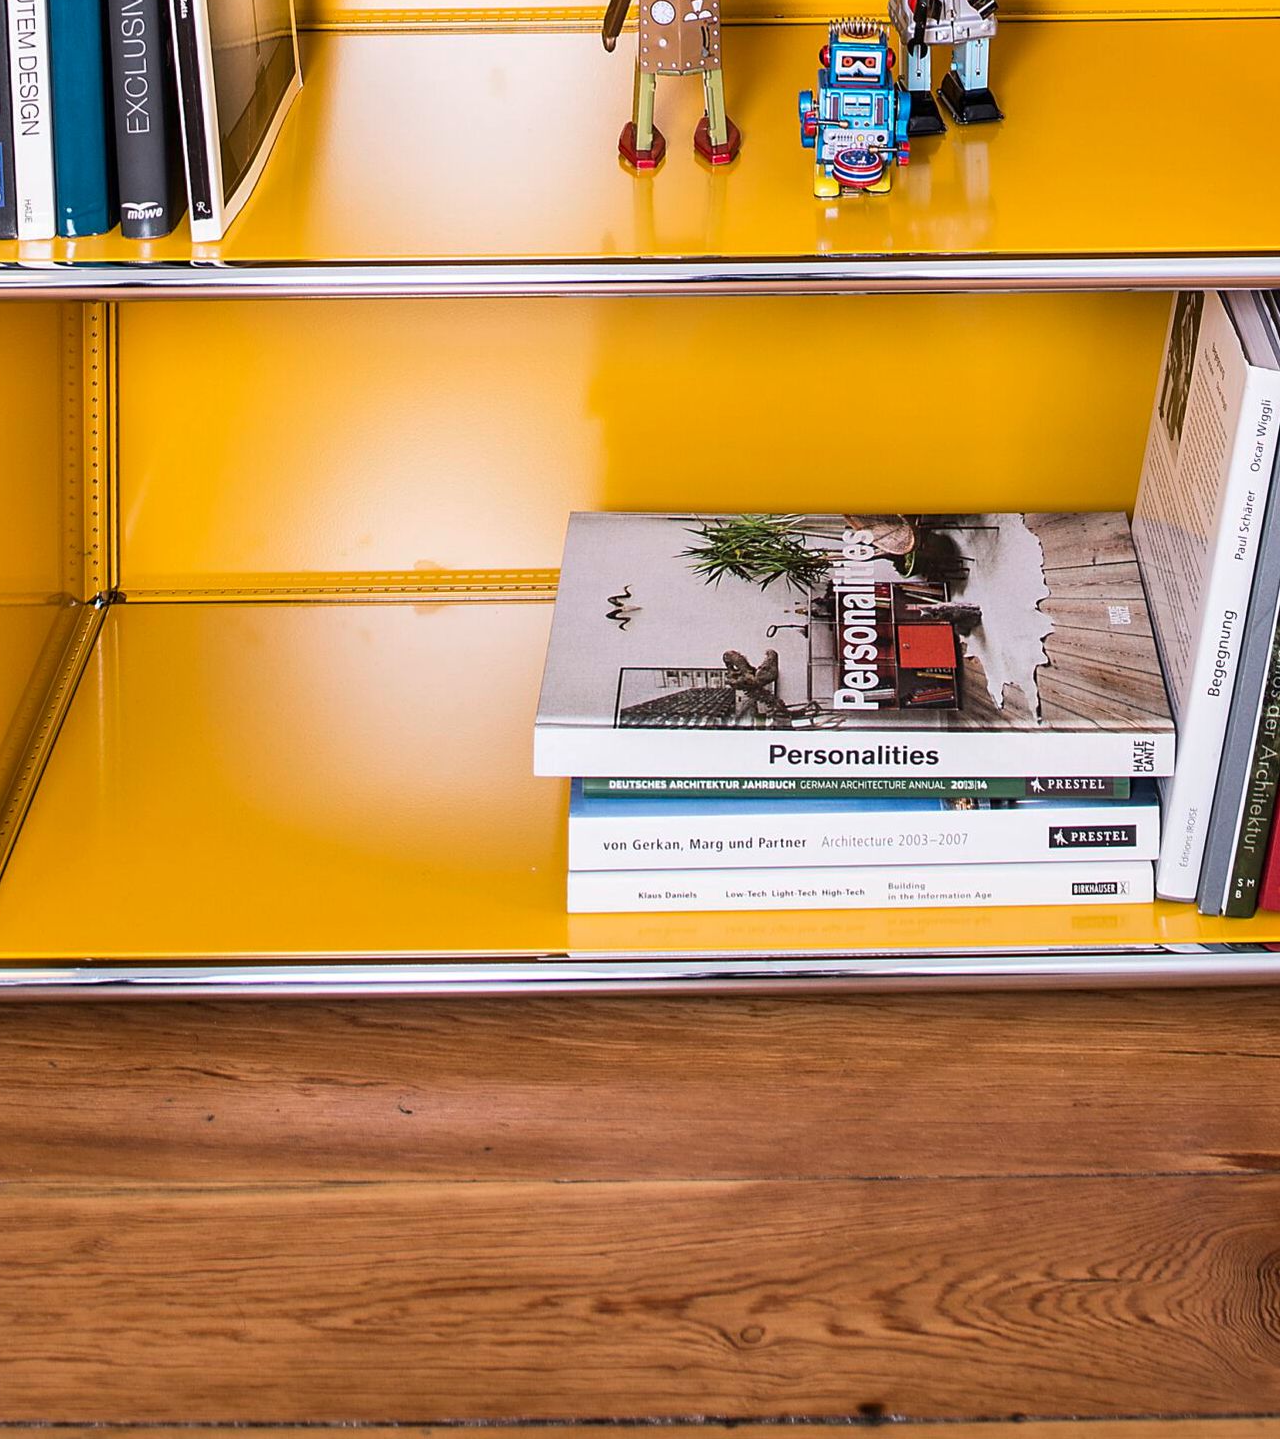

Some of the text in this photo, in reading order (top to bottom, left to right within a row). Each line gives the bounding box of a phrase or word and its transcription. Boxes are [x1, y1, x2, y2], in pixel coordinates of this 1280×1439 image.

[18, 56, 40, 136] DESIGN
[1207, 399, 1272, 697] Begegnung Paul Schärer Oscar Wiggli
[833, 529, 880, 711] Personalities
[768, 745, 940, 766] Personalities
[1133, 740, 1144, 773] HATJE
[1144, 740, 1156, 773] CANTZ
[609, 780, 667, 790] DEUTSCHES
[669, 780, 740, 790] ARCHITEKTUR
[742, 780, 796, 790] JAHRBUCH
[799, 780, 838, 790] GERMAN
[840, 780, 907, 790] ARCHITECTURE
[908, 780, 946, 789] ANNUAL
[1047, 779, 1105, 790] PRESTEL
[1243, 745, 1279, 854] Architektur
[603, 841, 627, 851] von
[632, 839, 685, 852] Gerkan,
[689, 838, 723, 852] Marg
[728, 837, 753, 850] und
[758, 837, 807, 849] Partner
[821, 835, 894, 848] Architecture
[1071, 830, 1129, 842] PRESTEL
[1179, 807, 1198, 868] Éditions IROISE
[888, 882, 926, 892] Building
[1237, 878, 1255, 888] S M
[638, 888, 866, 900] Klaus Daniels Low-Tech Light-Tech High-Tech
[888, 891, 993, 901] in the Information Age
[1235, 889, 1242, 899] B
